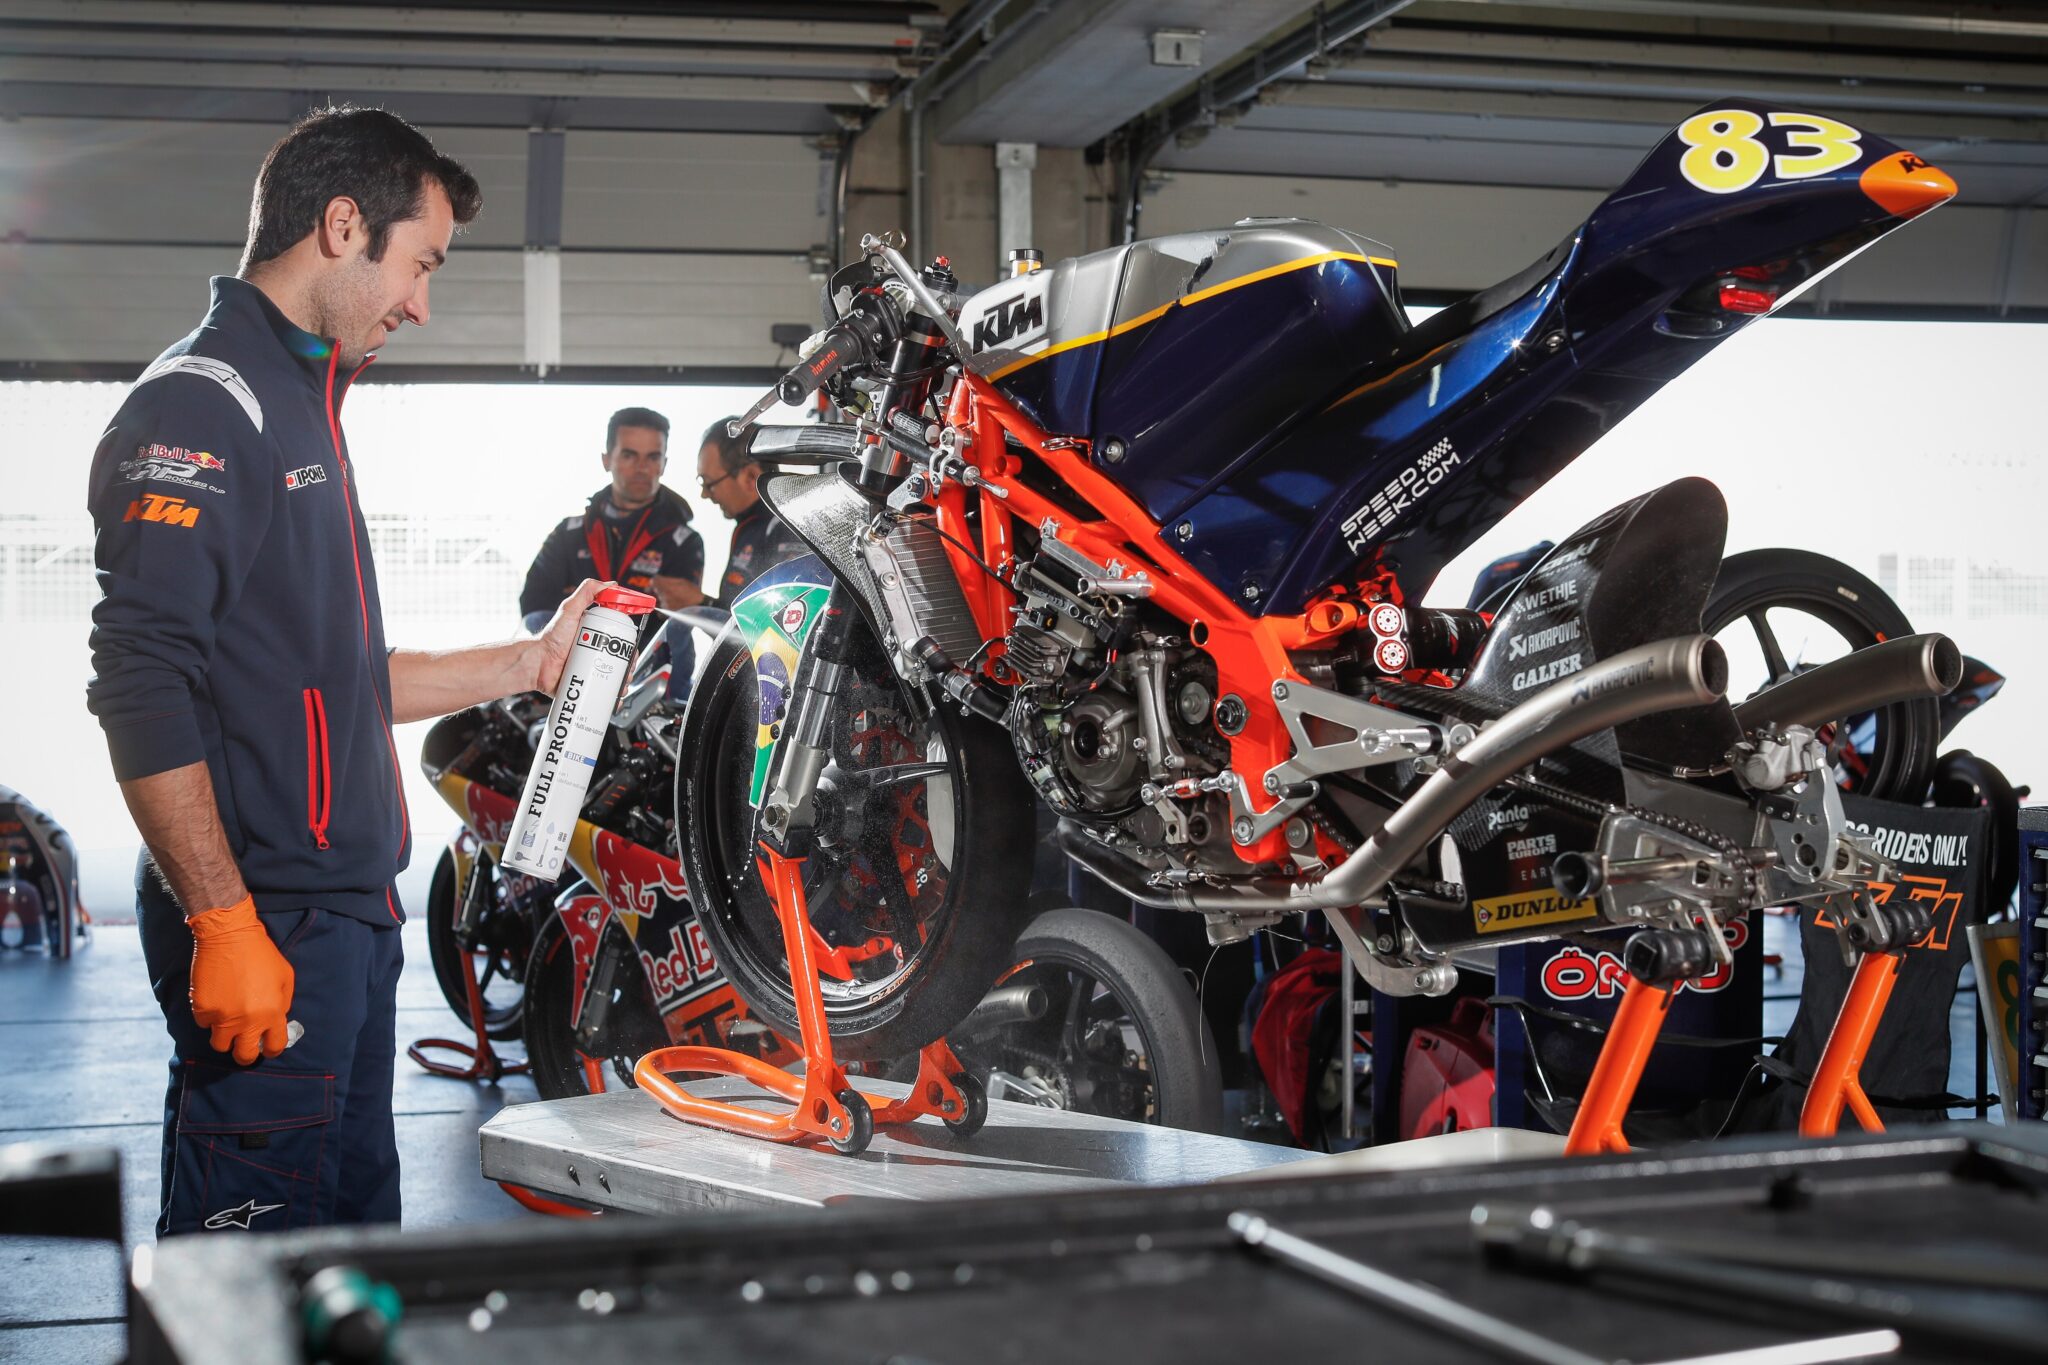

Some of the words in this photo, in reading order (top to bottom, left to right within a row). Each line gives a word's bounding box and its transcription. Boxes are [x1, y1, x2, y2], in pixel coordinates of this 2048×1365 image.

[1677, 109, 1863, 194] 83
[971, 292, 1045, 356] KTM
[156, 444, 183, 460] Bull
[208, 485, 226, 495] CUP
[296, 465, 326, 487] IPONE
[123, 493, 201, 528] KTM
[1341, 467, 1418, 538] SPEED
[1347, 451, 1461, 556] WEEK.COM
[1525, 580, 1577, 610] WETHJE
[1512, 653, 1582, 691] GALFER
[528, 770, 555, 818] FULL
[545, 675, 584, 765] PROTECT
[567, 751, 584, 763] BIKE
[1506, 833, 1556, 853] PARTS
[1508, 845, 1557, 860] EUROPE
[1871, 826, 1932, 865] RIDERS
[1932, 834, 1969, 867] ONLY!
